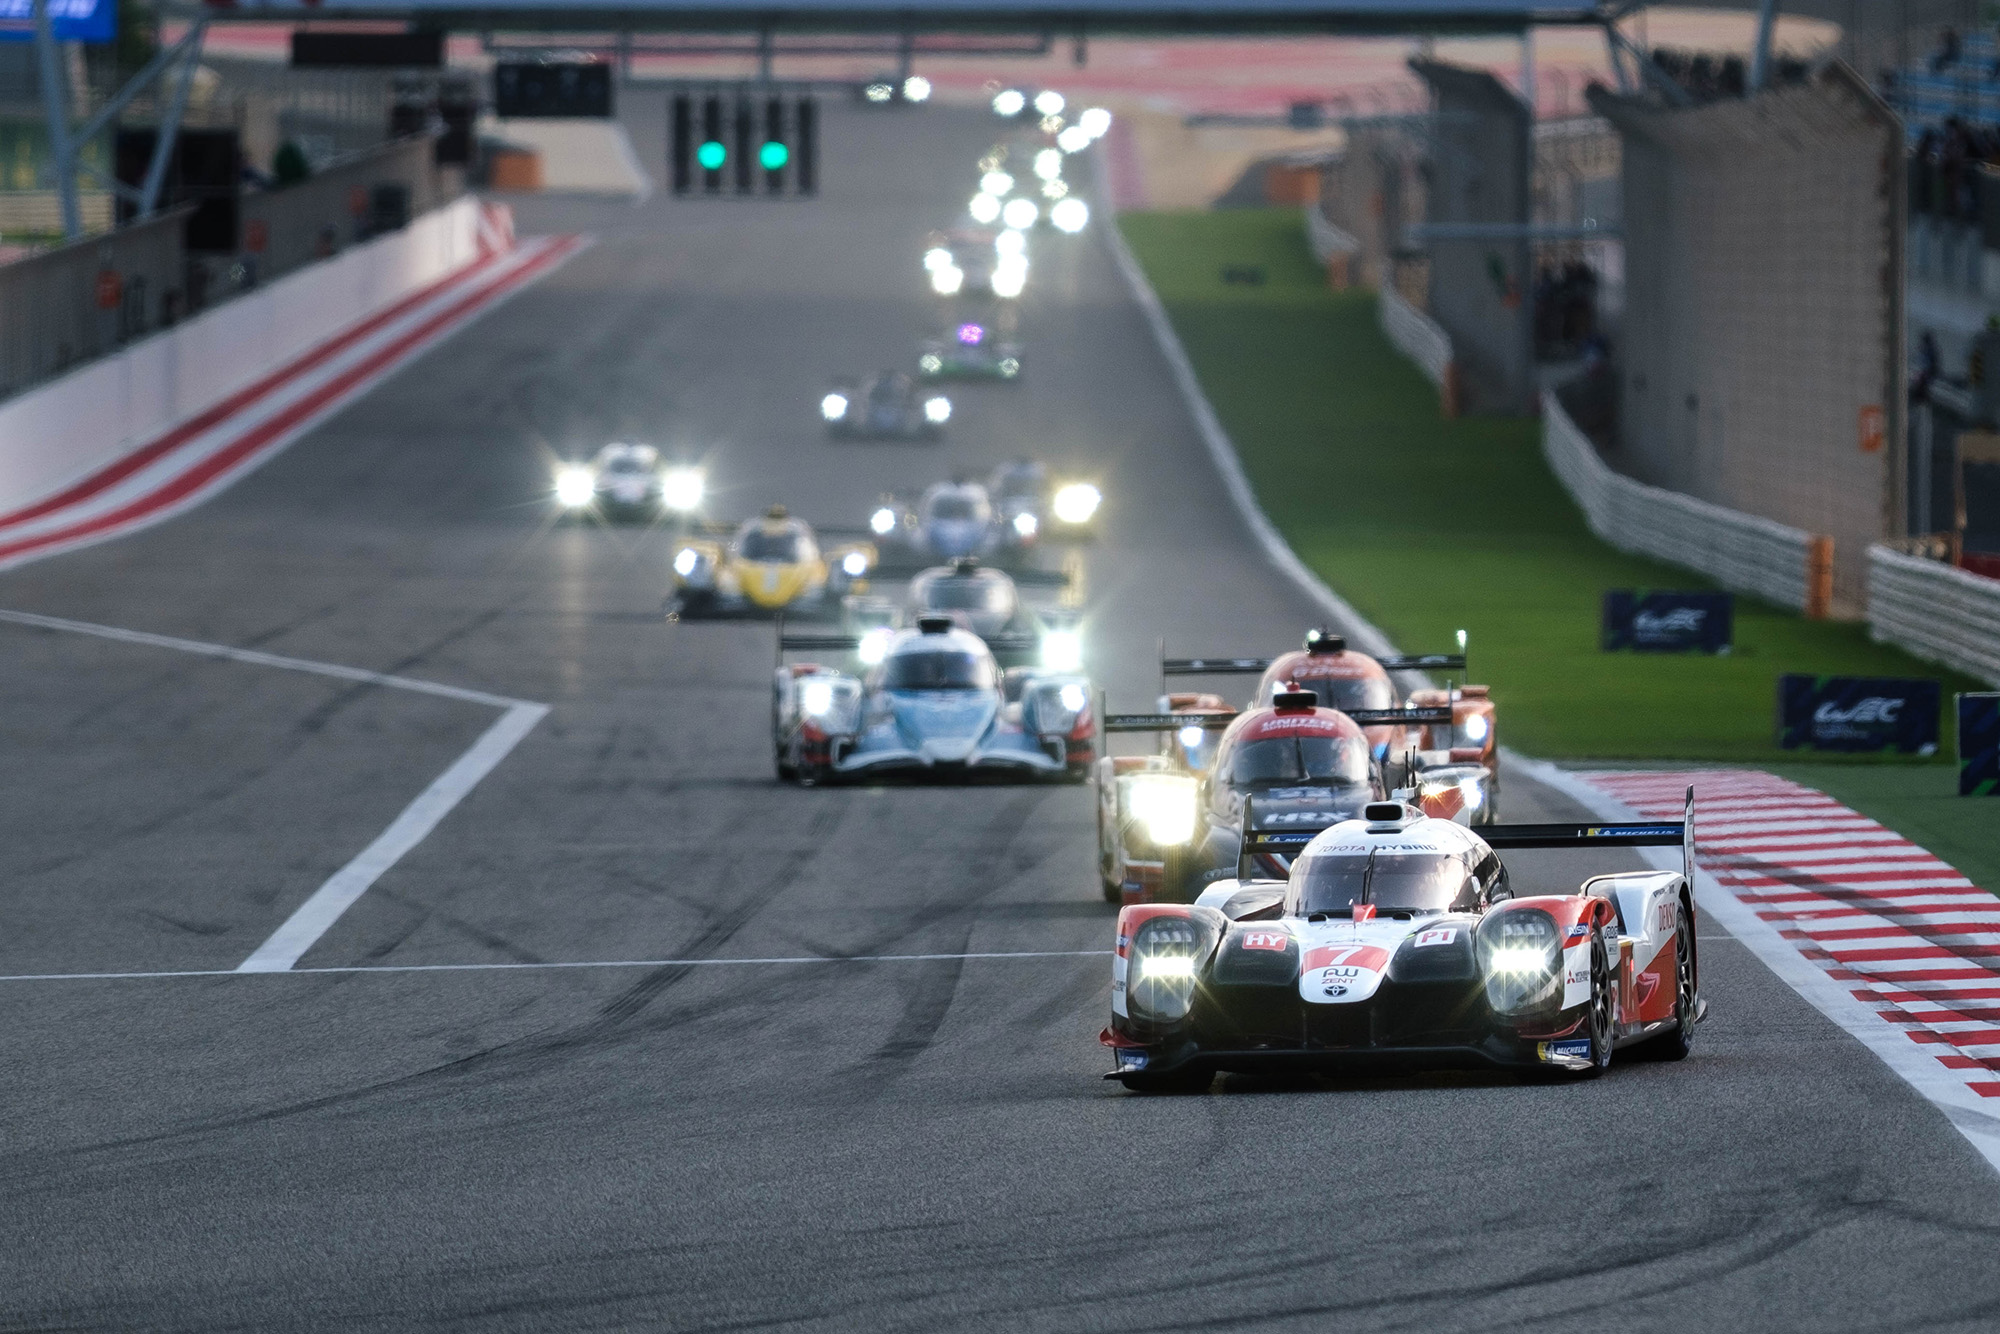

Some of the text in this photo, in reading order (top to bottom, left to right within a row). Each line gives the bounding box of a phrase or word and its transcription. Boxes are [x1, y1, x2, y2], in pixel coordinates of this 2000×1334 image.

[1814, 697, 1904, 722] WEC
[1319, 845, 1366, 853] TOYOTA
[1246, 934, 1284, 947] HY
[1421, 930, 1451, 943] P1
[1328, 946, 1364, 965] 7
[1556, 1046, 1588, 1054] MICHELIN
